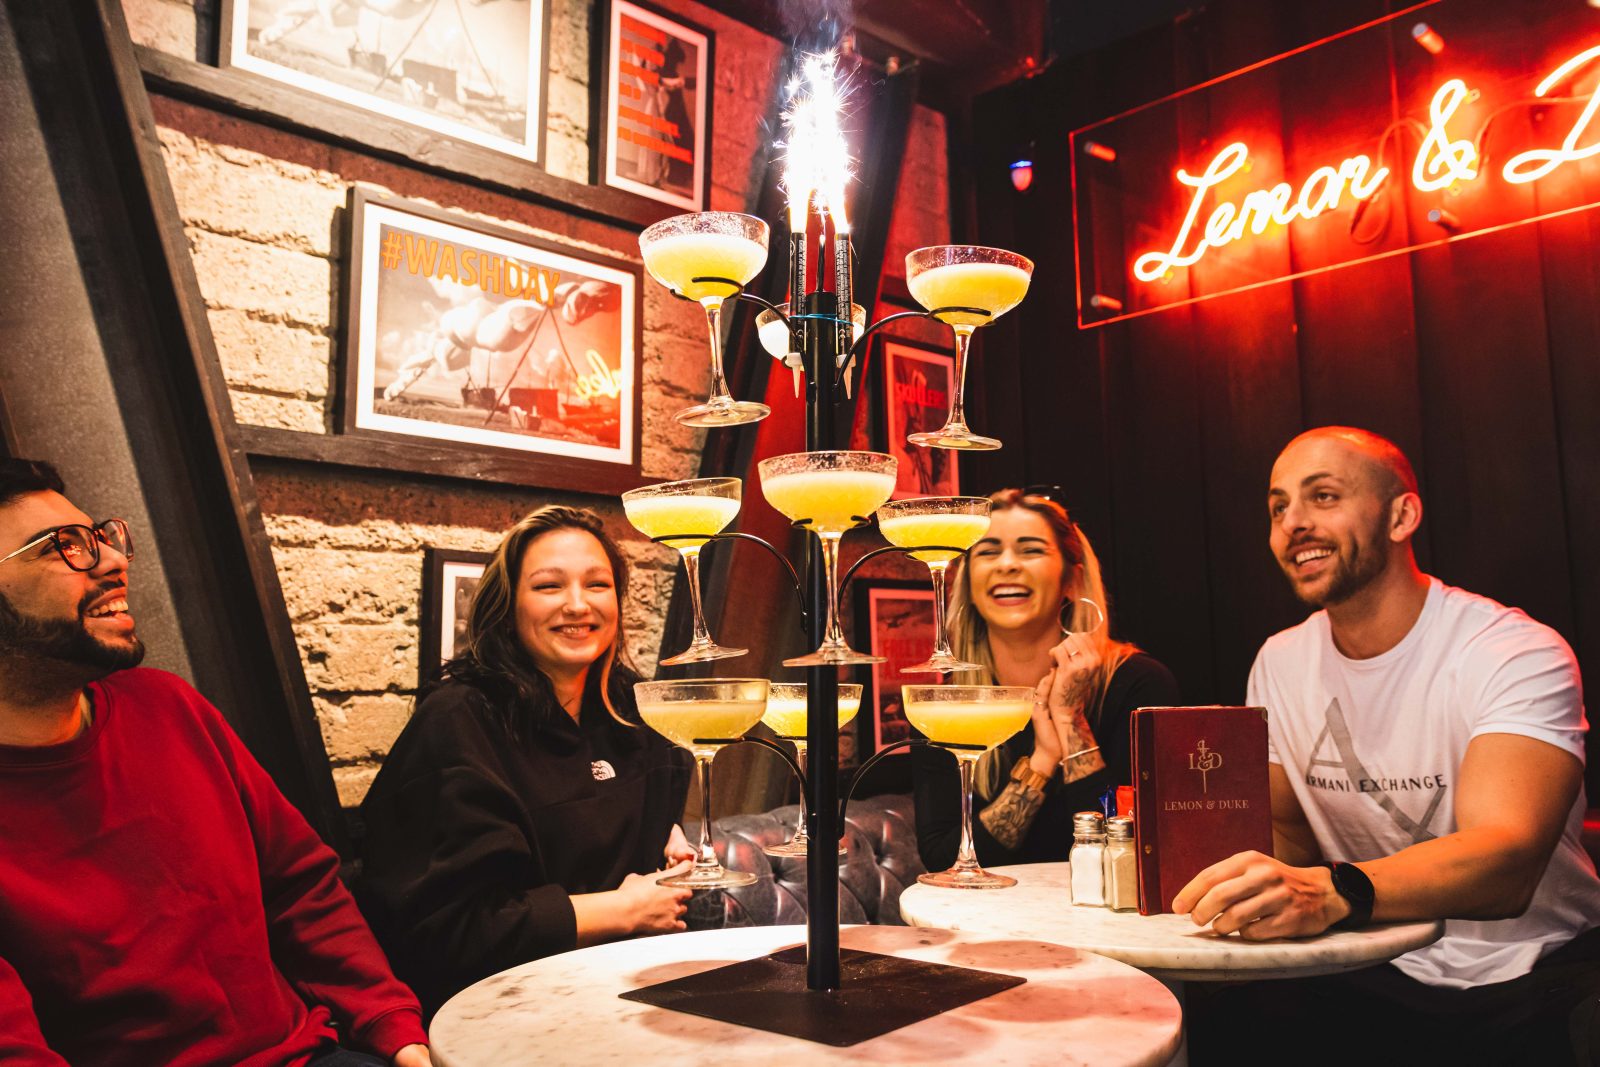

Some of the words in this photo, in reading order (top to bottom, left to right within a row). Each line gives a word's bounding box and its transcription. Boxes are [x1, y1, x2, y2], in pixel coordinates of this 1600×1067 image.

[1133, 142, 1388, 283] Lemon
[1411, 78, 1477, 192] &
[381, 231, 560, 306] #WASHDAY
[1164, 800, 1203, 811] LEMON
[1206, 800, 1216, 810] &
[1219, 799, 1250, 809] DUKE
[1359, 774, 1448, 793] EXCHANGE
